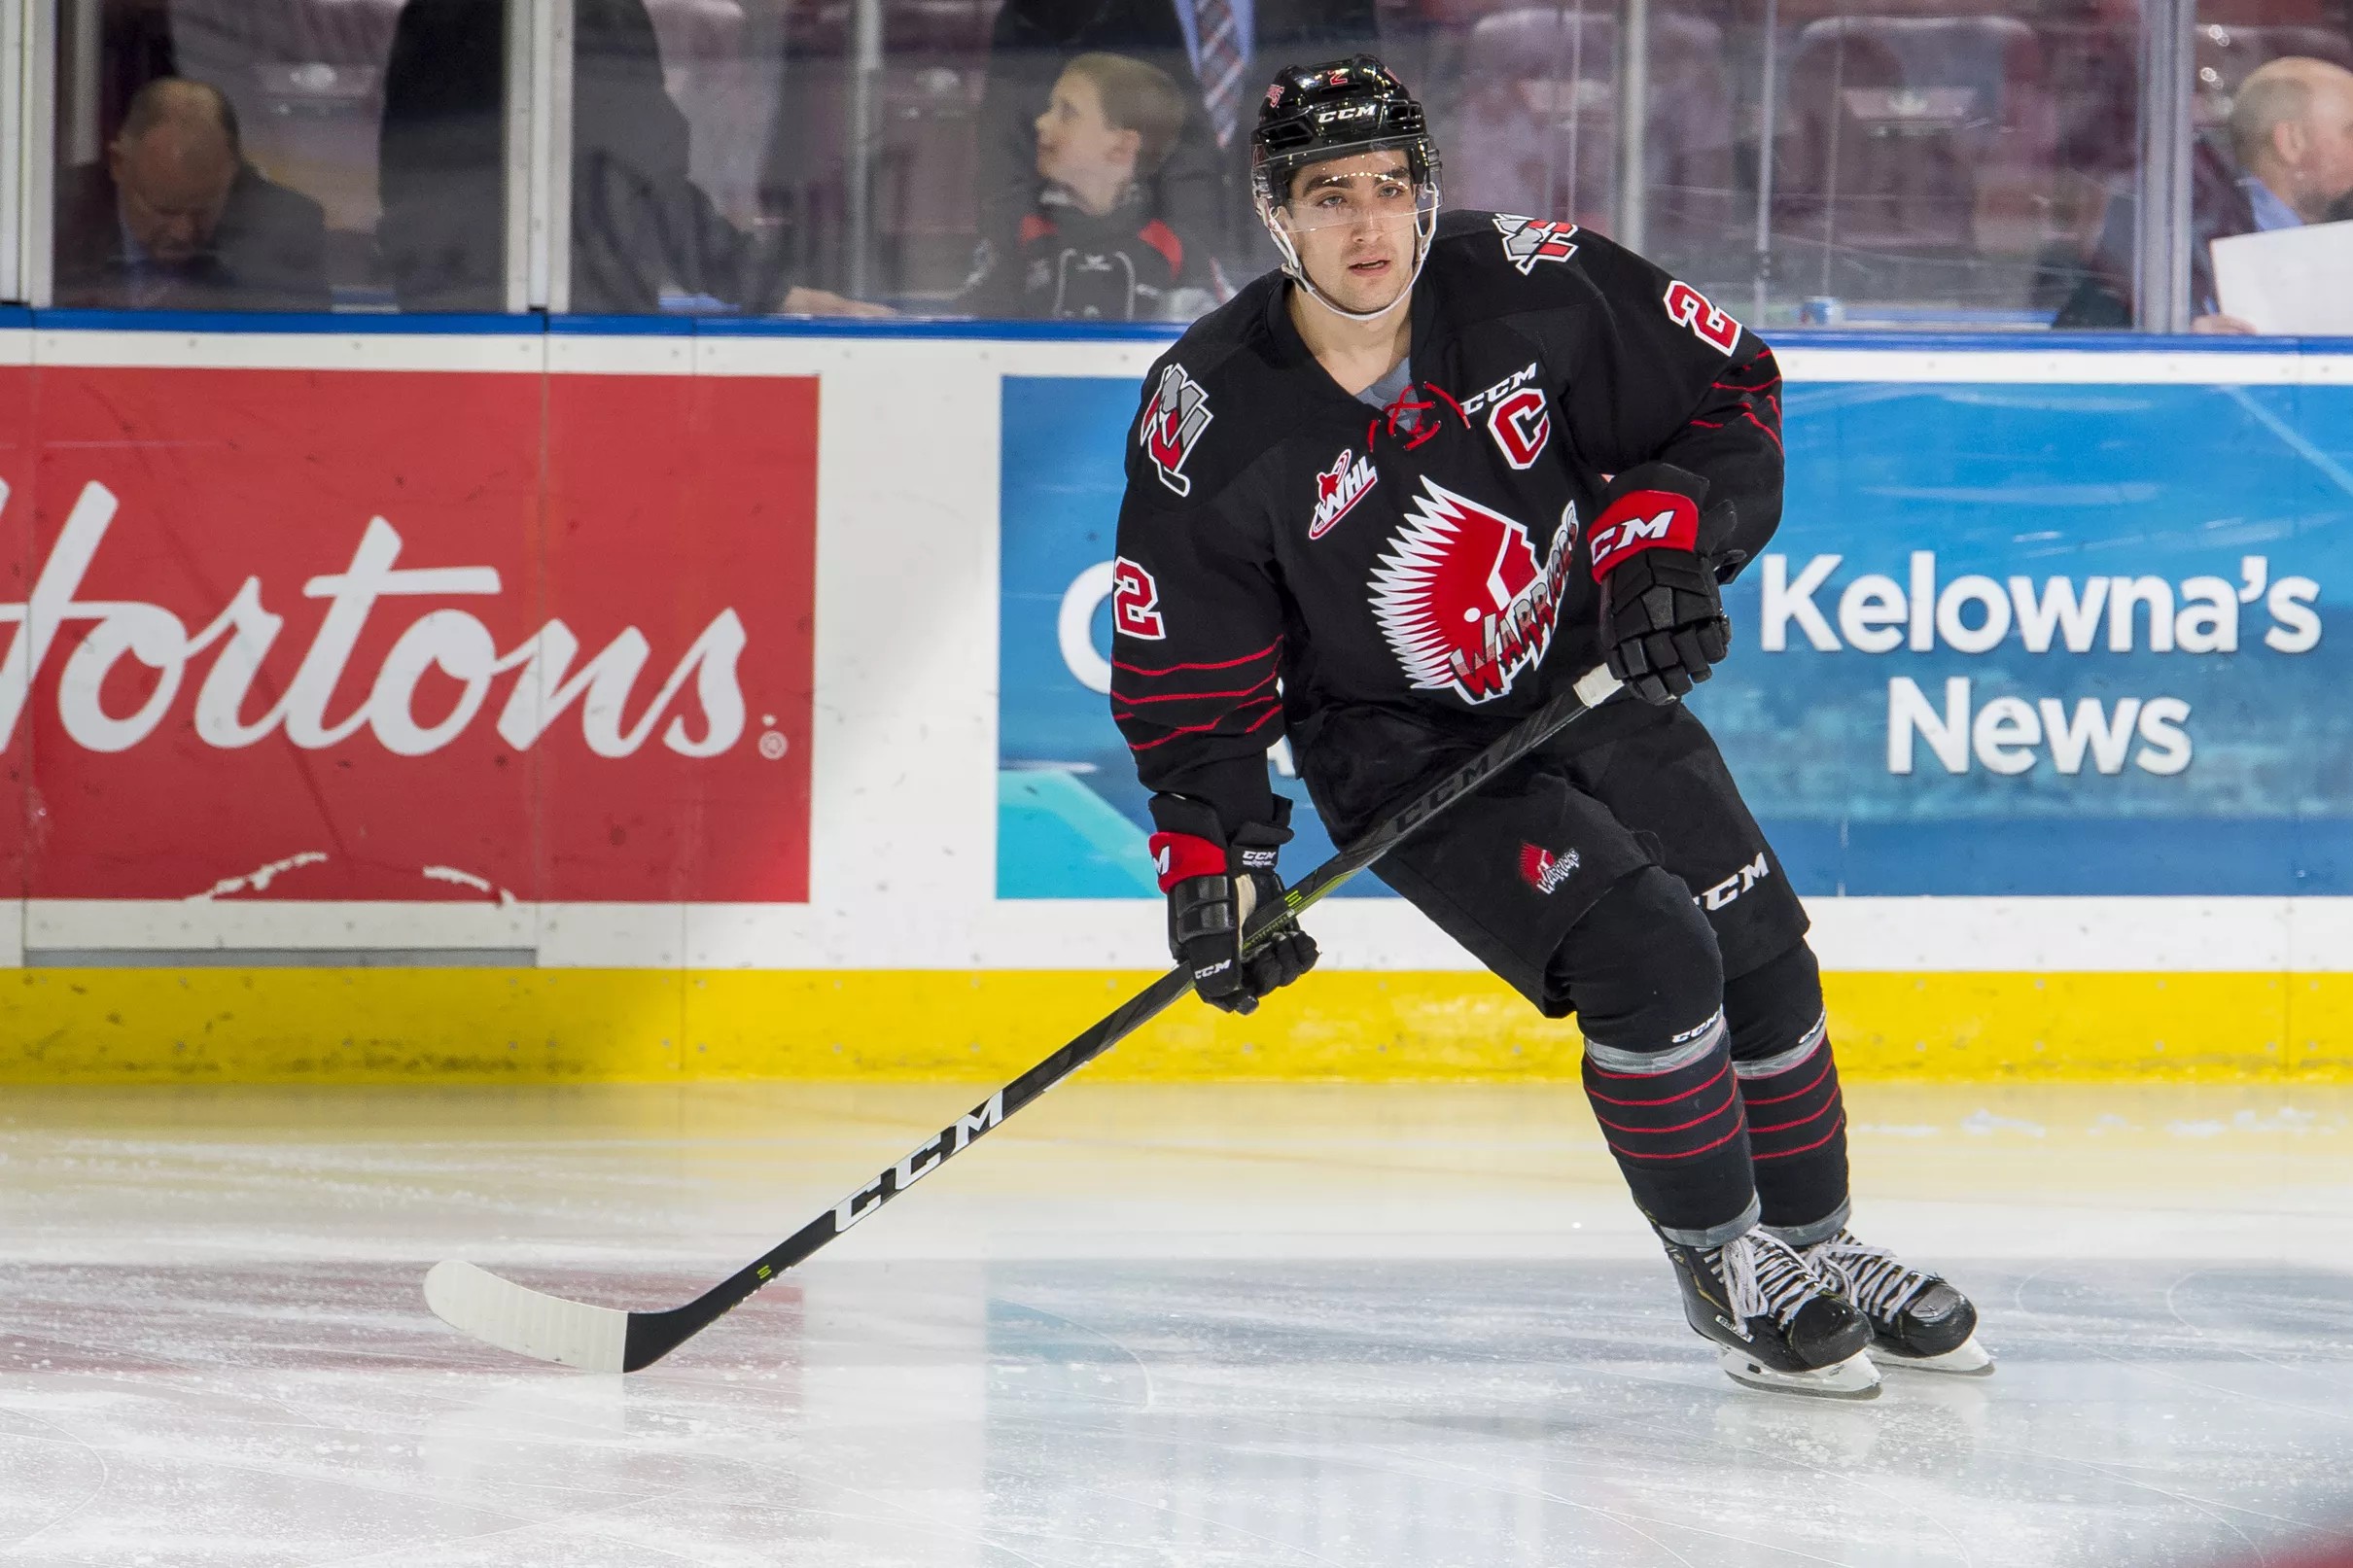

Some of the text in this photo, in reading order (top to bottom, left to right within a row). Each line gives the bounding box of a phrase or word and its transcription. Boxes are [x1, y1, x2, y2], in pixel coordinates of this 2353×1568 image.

[1317, 104, 1377, 124] CCM
[1663, 280, 1742, 357] 2
[1459, 362, 1537, 415] CCM
[1488, 387, 1551, 470] C
[1314, 456, 1378, 526] WHL
[1114, 555, 1166, 640] 2
[1761, 550, 2323, 654] Kelowna's
[1888, 677, 2193, 776] News
[1396, 753, 1490, 833] CCM
[1243, 850, 1277, 860] CCM
[1693, 852, 1770, 911] CM
[1195, 958, 1232, 980] CCM
[830, 1088, 1003, 1233] CCM
